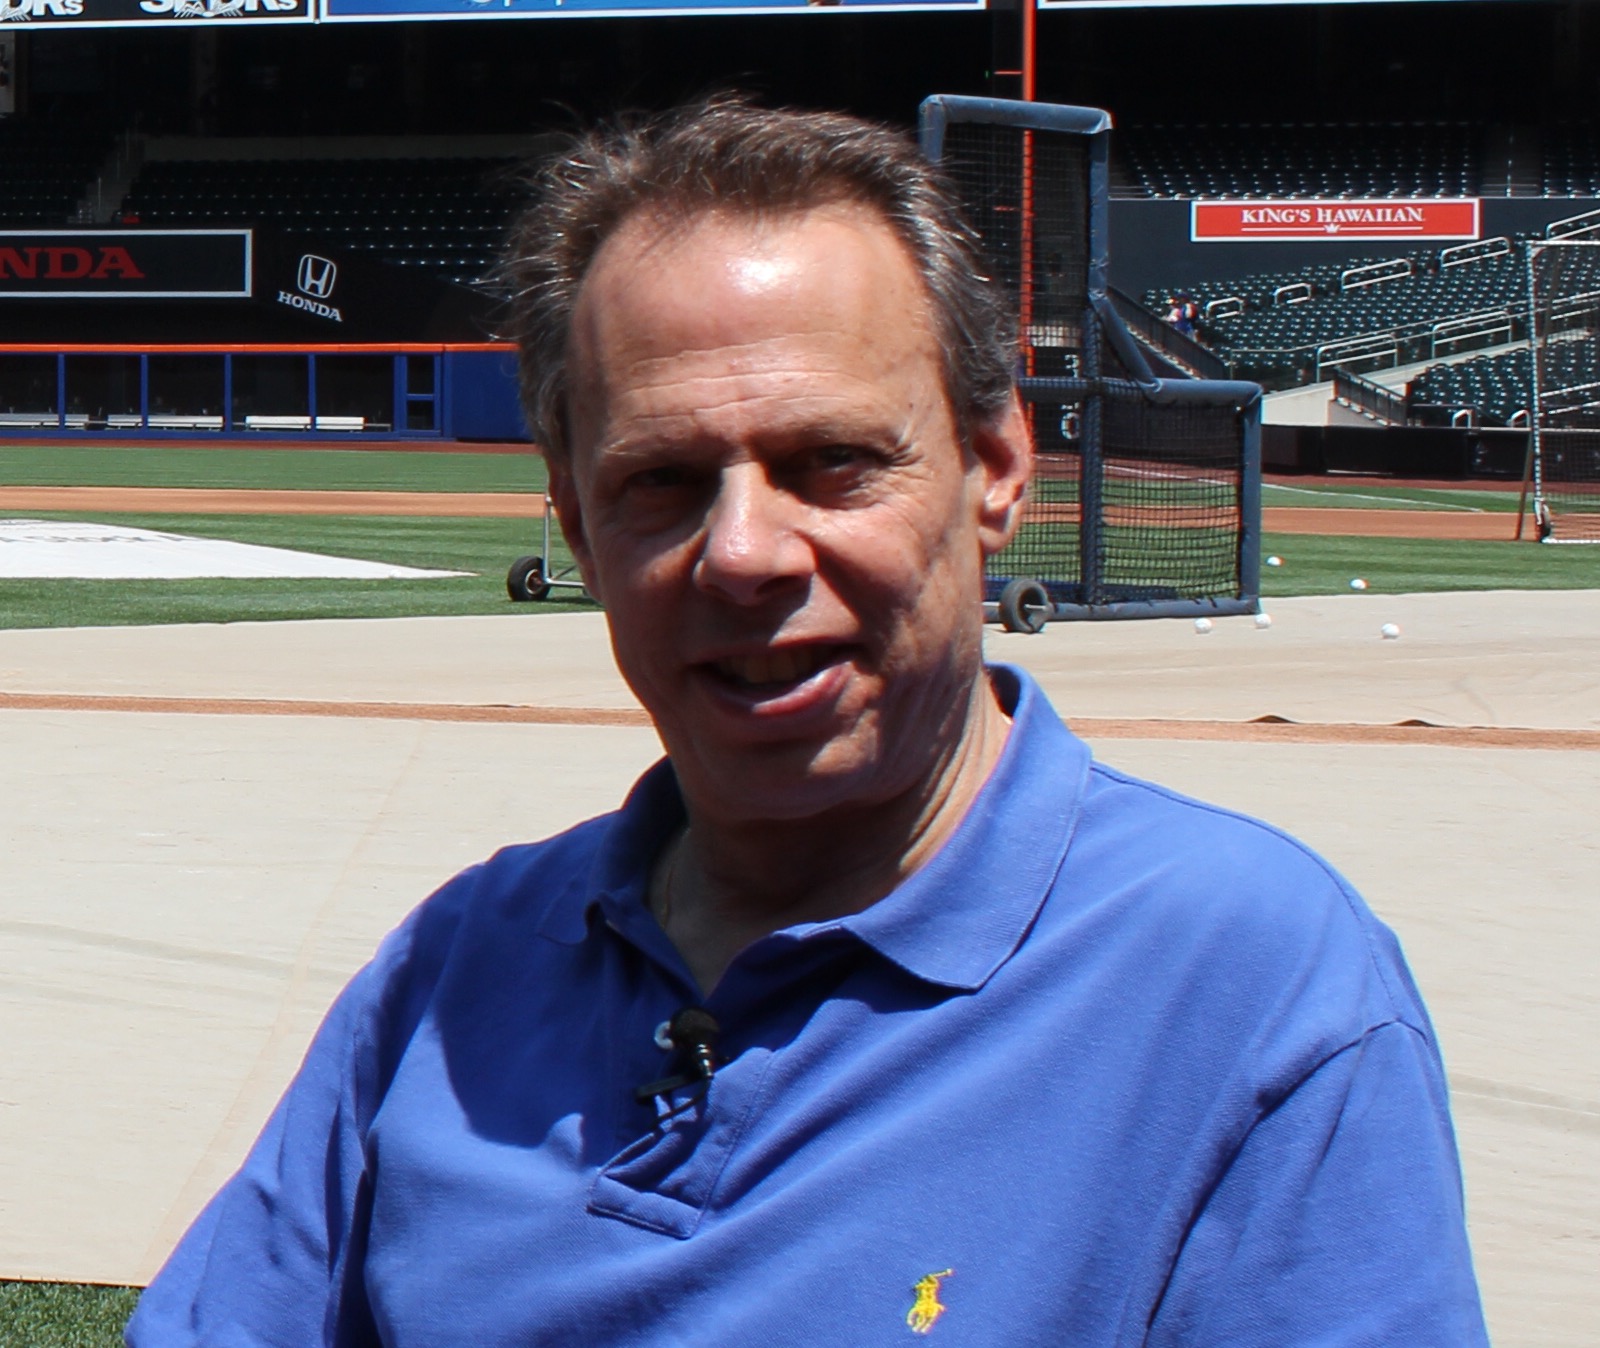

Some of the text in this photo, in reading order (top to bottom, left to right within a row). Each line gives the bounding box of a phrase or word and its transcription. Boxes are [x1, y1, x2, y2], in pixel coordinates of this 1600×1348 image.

[1241, 207, 1423, 223] KING'S HAWAIIAN
[277, 290, 343, 322] HONDA
